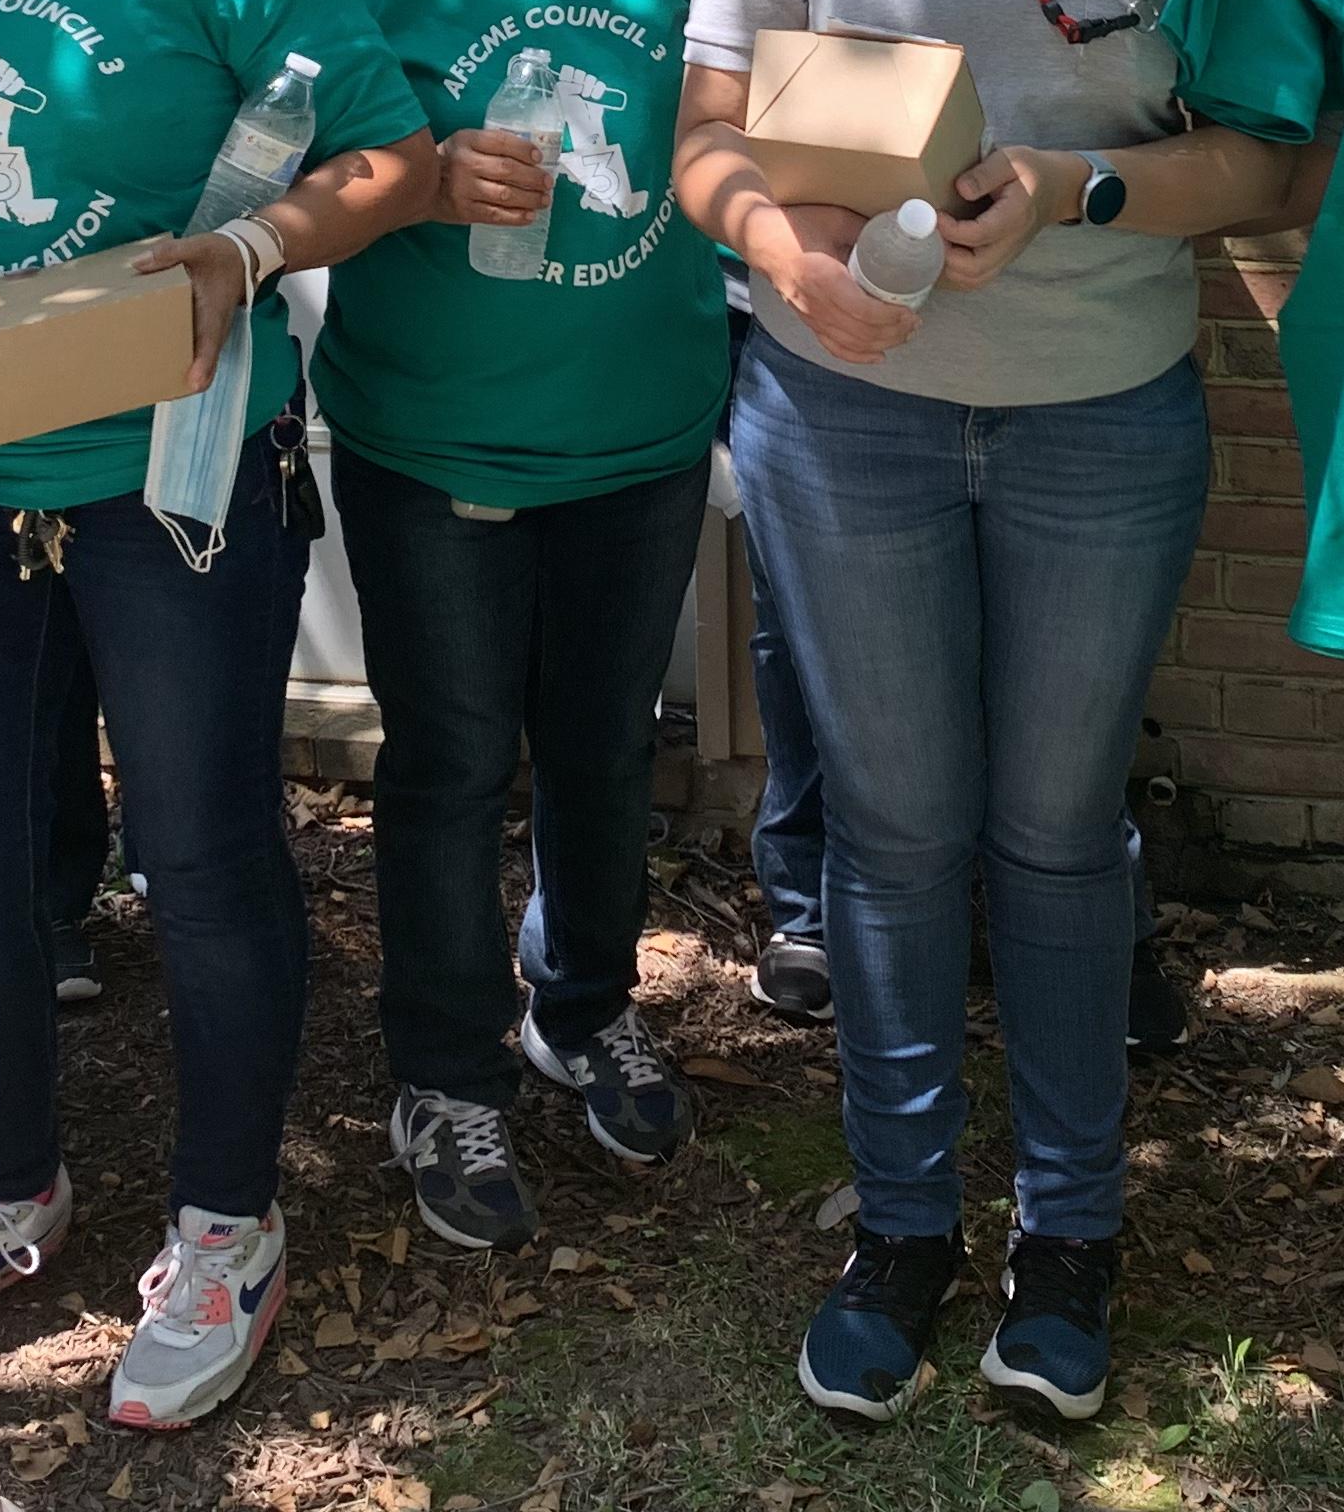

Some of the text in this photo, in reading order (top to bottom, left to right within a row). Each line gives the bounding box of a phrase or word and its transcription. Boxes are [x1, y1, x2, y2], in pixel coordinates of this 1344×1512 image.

[443, 5, 667, 100] AFSCME COUNCIL 3
[98, 57, 125, 75] 3
[208, 1223, 235, 1236] NIKE
